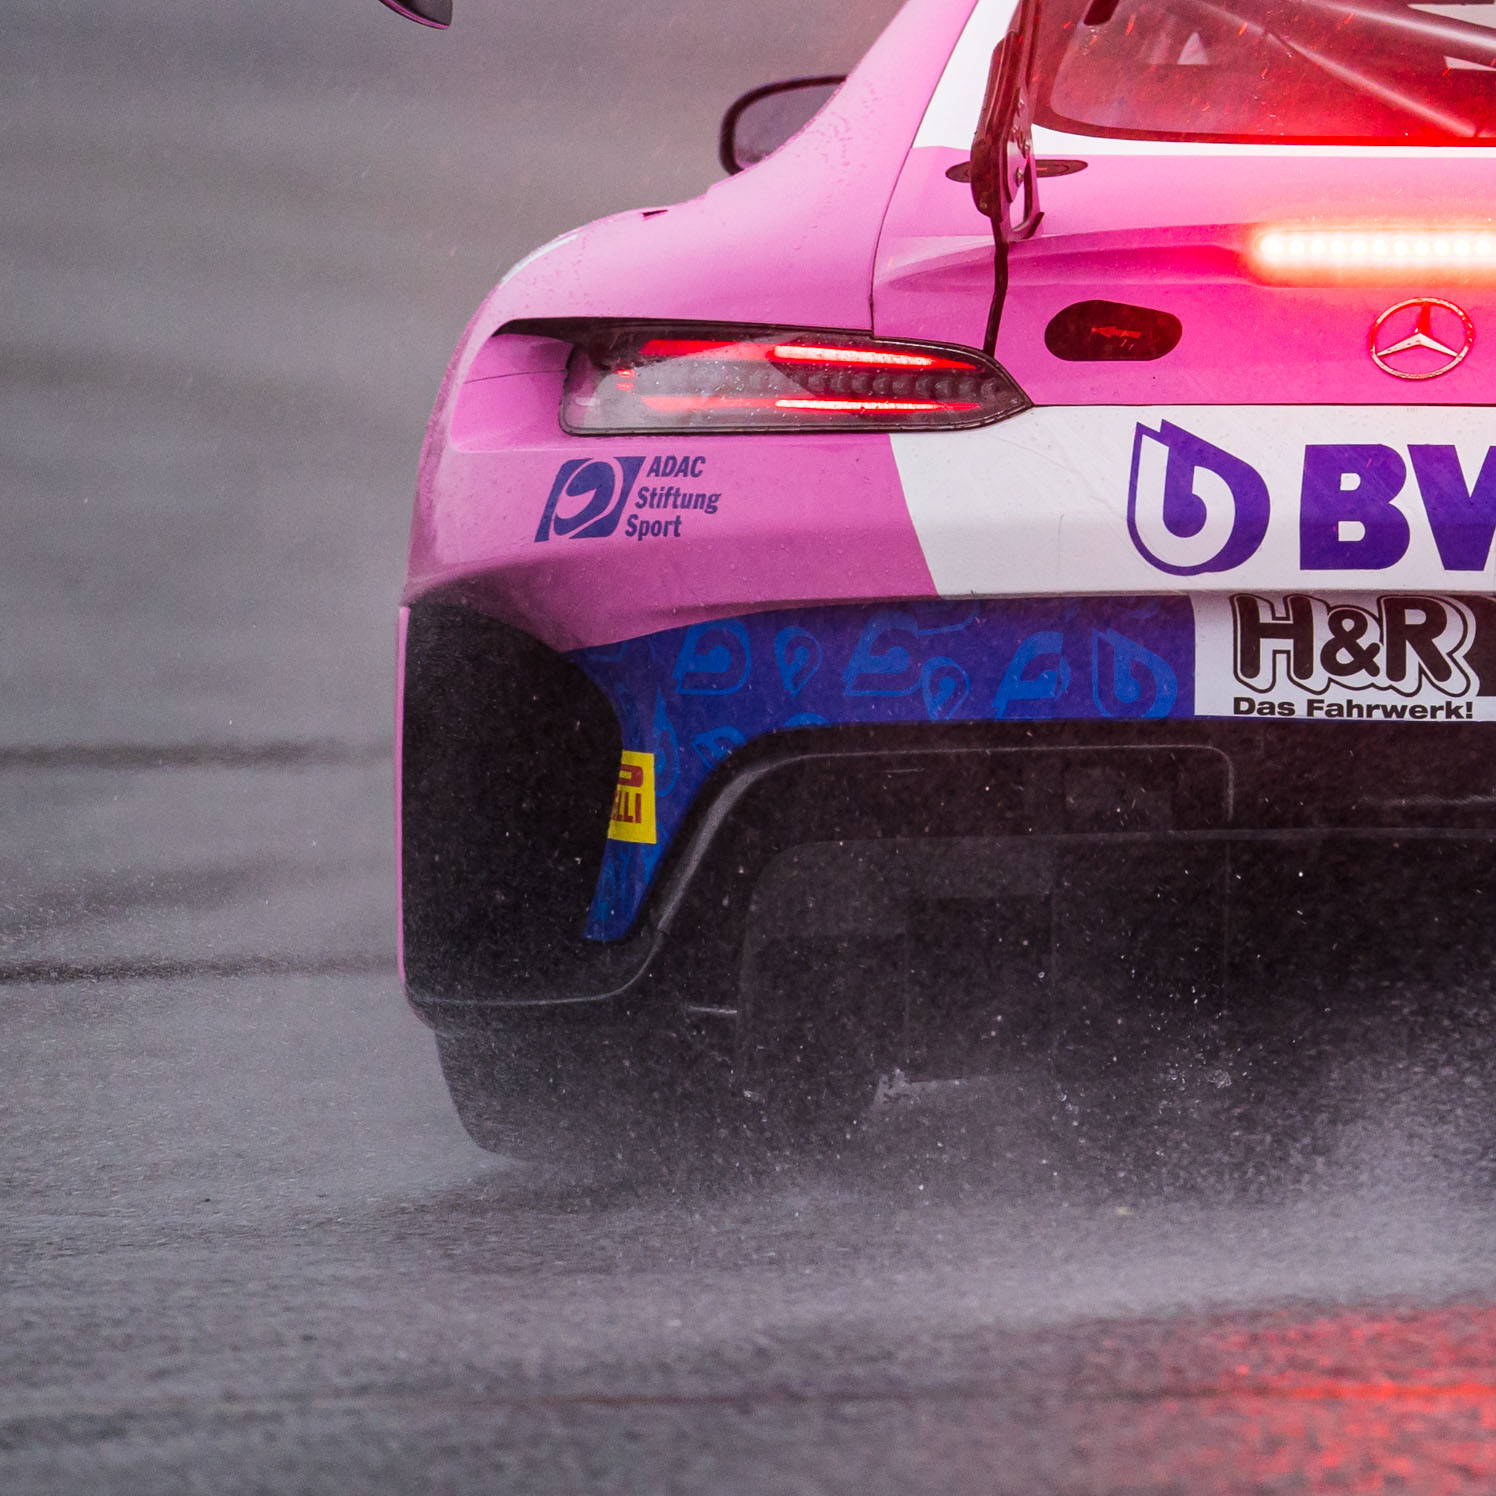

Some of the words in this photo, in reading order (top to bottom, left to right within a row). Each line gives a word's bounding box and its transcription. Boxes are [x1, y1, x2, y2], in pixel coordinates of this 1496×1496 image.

[646, 455, 706, 478] ADAC
[634, 486, 721, 514] Stiftung
[624, 513, 682, 541] Sport
[1229, 593, 1472, 698] H&R
[1233, 697, 1296, 717] Das
[1306, 699, 1473, 720] Fahrwerk!
